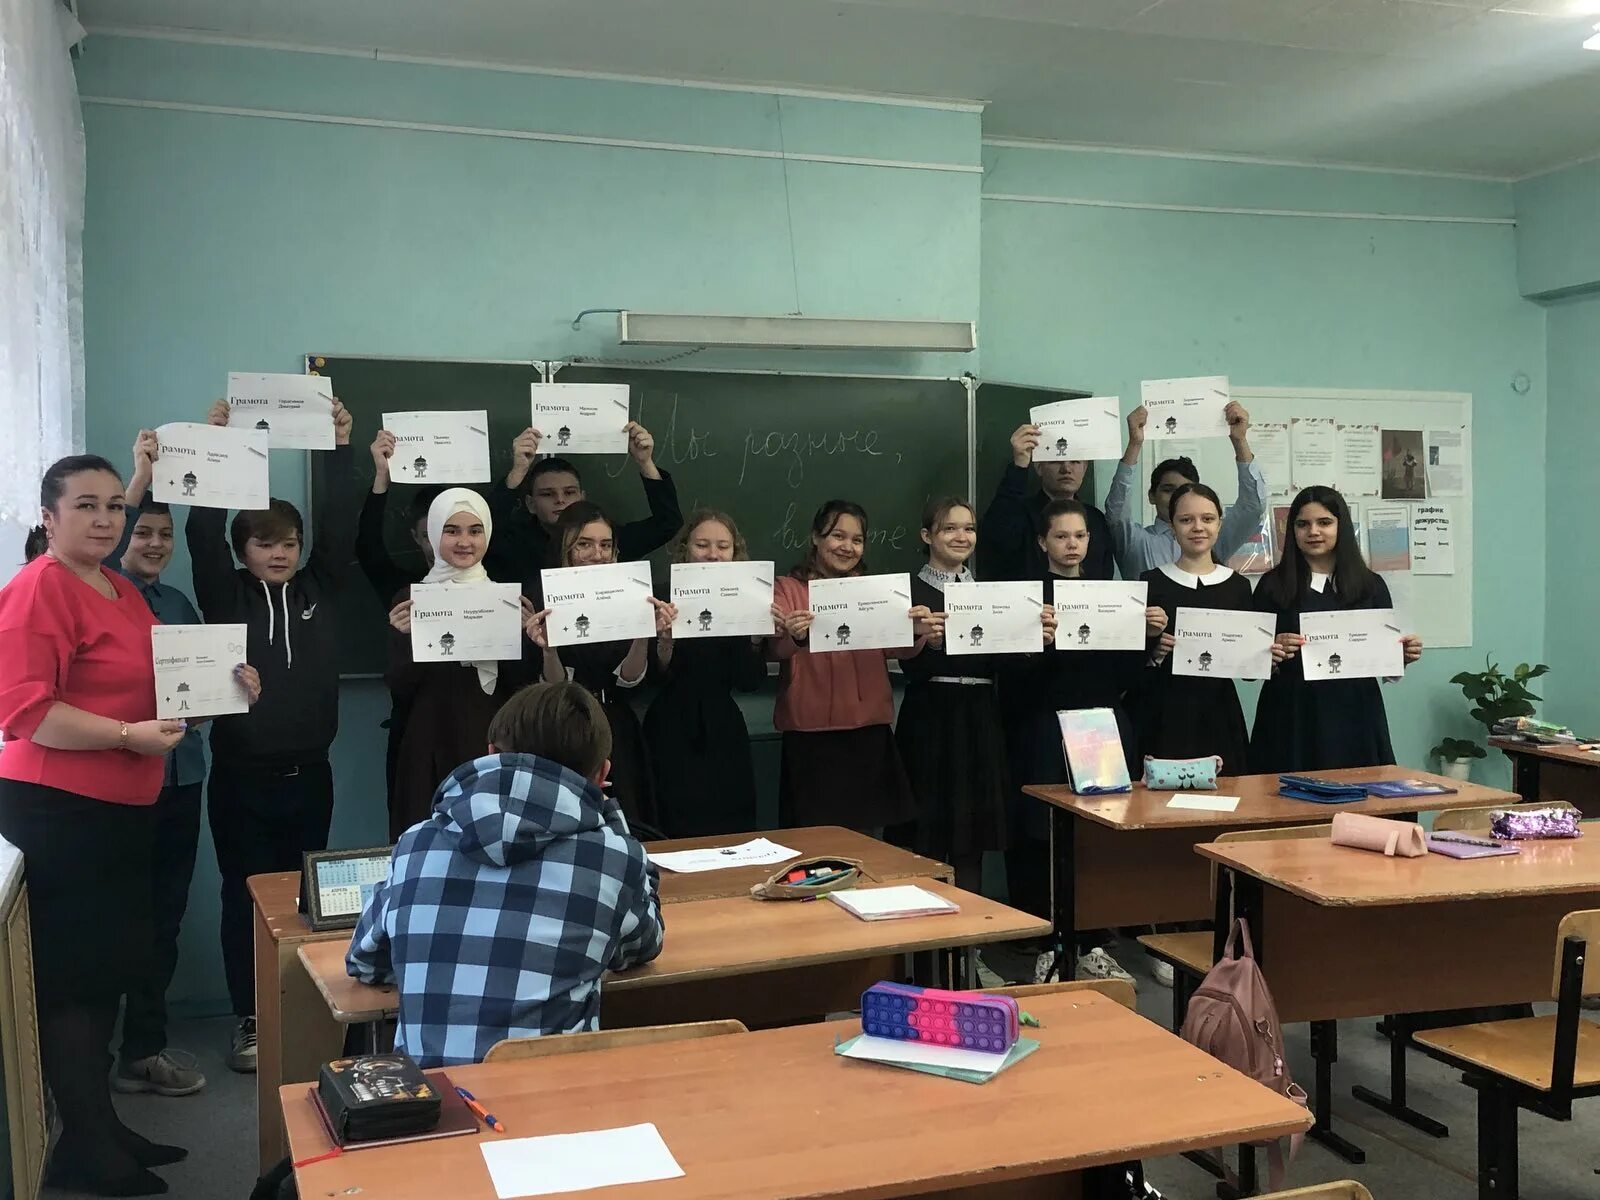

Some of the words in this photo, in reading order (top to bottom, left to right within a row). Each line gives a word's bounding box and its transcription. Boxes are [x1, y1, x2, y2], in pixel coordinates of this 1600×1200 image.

[230, 396, 268, 405] Грамота
[1144, 399, 1175, 407] Грамота
[535, 403, 570, 412] Грамота
[156, 443, 196, 456] Грамота
[1417, 506, 1444, 514] график
[674, 587, 710, 597] Грамота
[547, 592, 585, 603] Грамота
[812, 602, 848, 613] Грамота
[948, 602, 983, 612] Грамота
[1057, 602, 1089, 611] Грамота
[414, 609, 453, 619] Грамота
[1178, 628, 1212, 638] Грамота
[1304, 633, 1339, 642] Грамота
[155, 656, 189, 666] Сертификат
